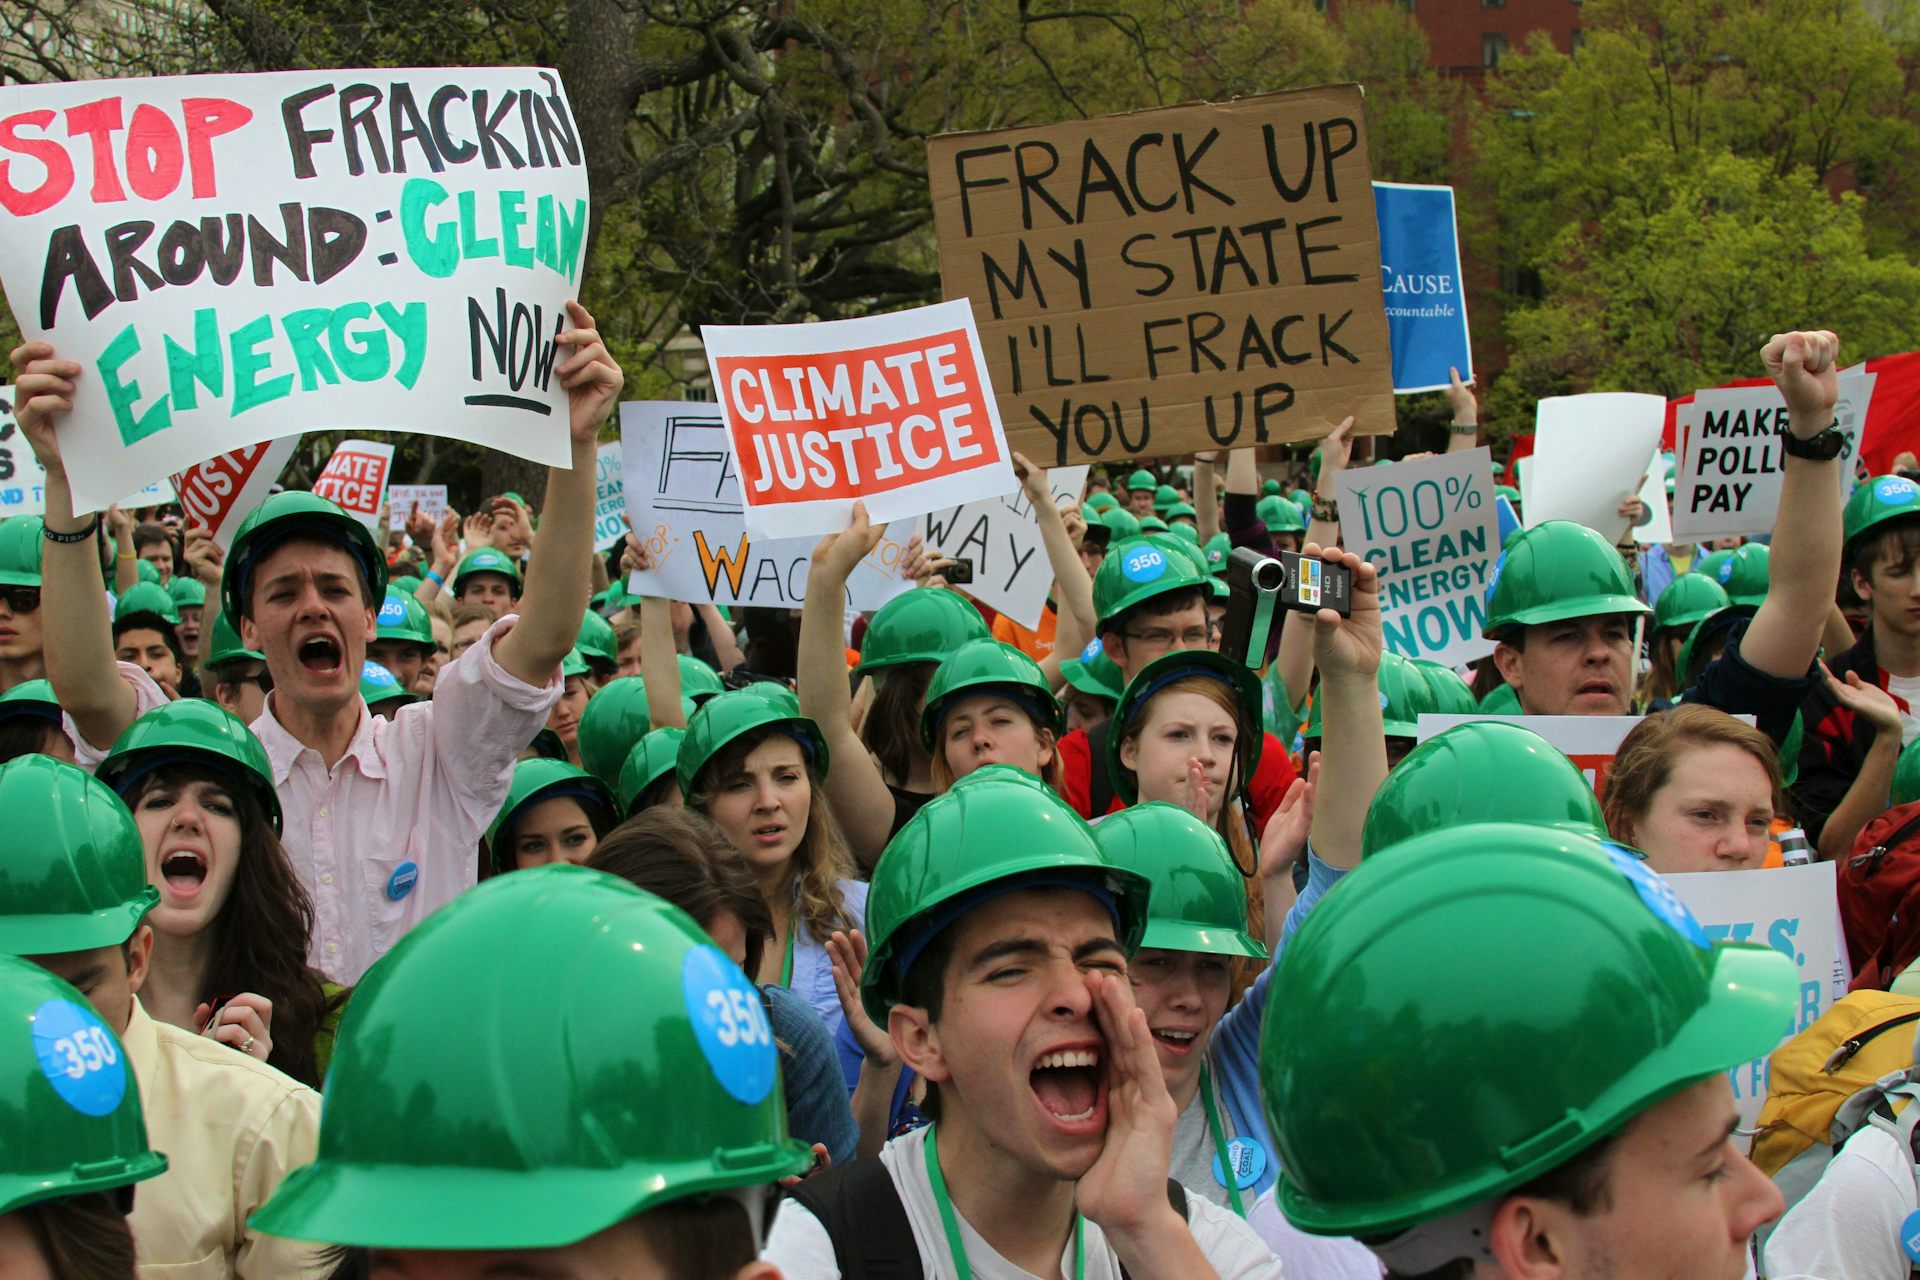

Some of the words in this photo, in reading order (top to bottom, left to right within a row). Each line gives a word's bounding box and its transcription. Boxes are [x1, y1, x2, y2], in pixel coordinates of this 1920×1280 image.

[0, 96, 254, 217] STOP
[955, 127, 1235, 238] FRACK
[1262, 117, 1358, 203] UP
[982, 238, 1092, 320] MY
[1121, 216, 1359, 296] STATE
[1384, 303, 1455, 317] ccountable
[97, 301, 427, 447] ENERGY
[467, 287, 565, 392] NOW
[1008, 322, 1112, 395] I'LL
[1144, 309, 1361, 381] FRACK
[730, 343, 967, 425] CLIMATE
[753, 402, 983, 493] JUSTICE
[1029, 398, 1151, 467] YOU
[1205, 382, 1295, 447] UP
[1702, 407, 1788, 439] MAKE
[324, 454, 381, 483] MATE
[1690, 482, 1753, 513] PAY
[1882, 483, 1912, 497] 350
[1348, 474, 1481, 541] 100%
[926, 503, 1035, 592] WAY
[1129, 551, 1162, 573] 350
[1364, 525, 1486, 578] CLEAN
[1324, 575, 1331, 594] HD
[1381, 590, 1488, 658] NOW
[706, 988, 771, 1047] 350
[54, 1026, 117, 1079] 350
[1241, 1149, 1251, 1173] COAL
